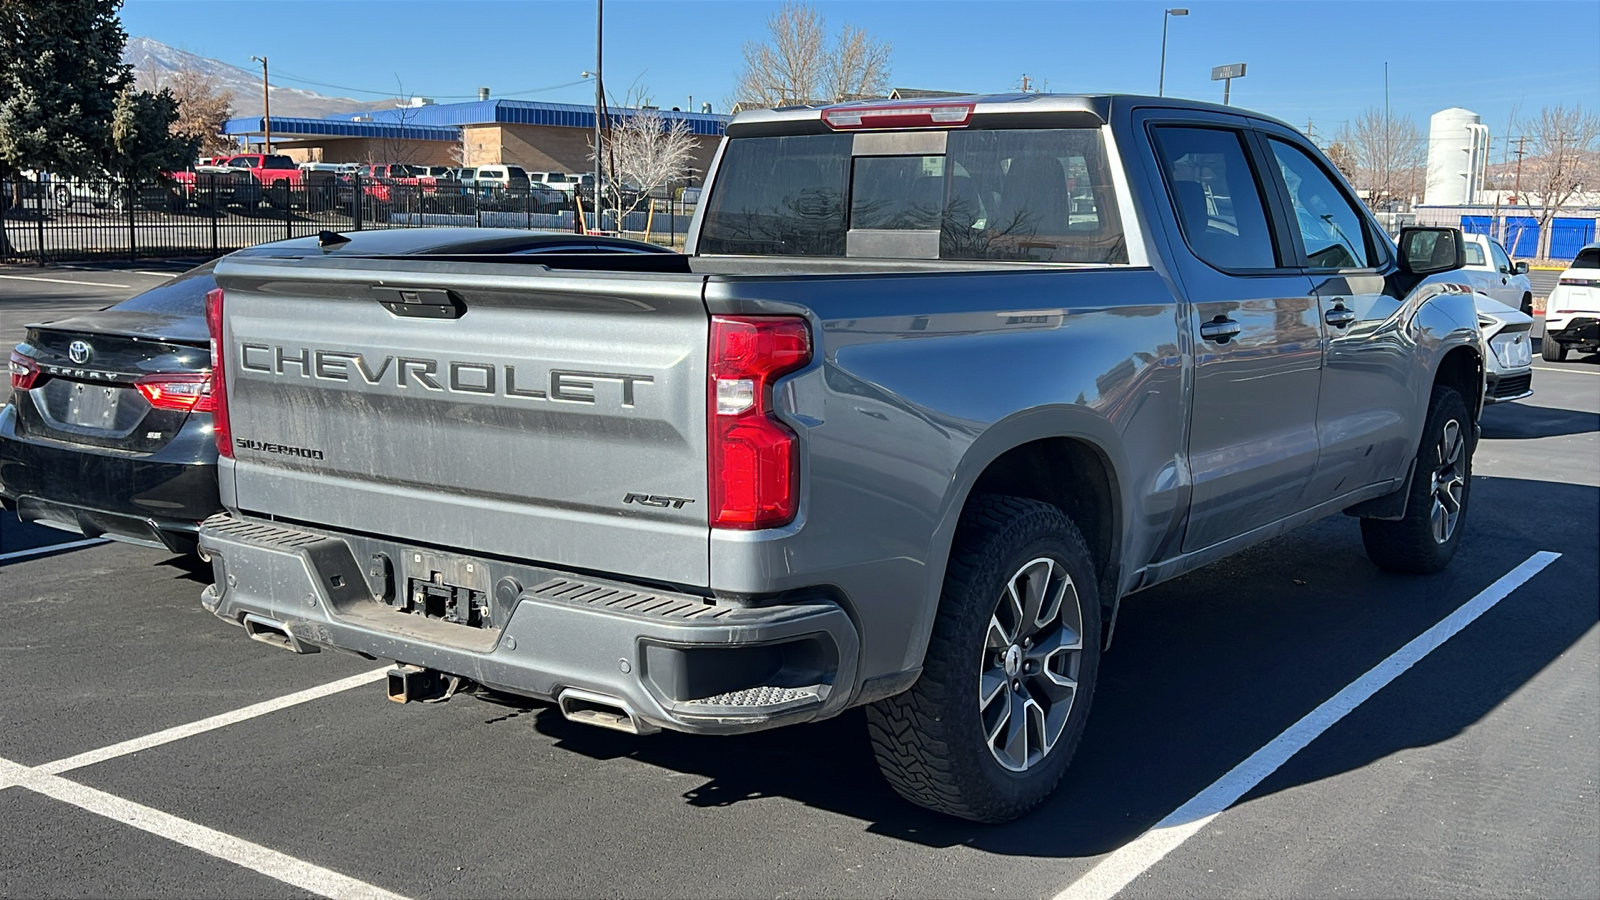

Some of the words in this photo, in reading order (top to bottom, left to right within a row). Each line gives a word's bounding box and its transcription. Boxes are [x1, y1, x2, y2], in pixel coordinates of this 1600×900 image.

[50, 367, 117, 380] CAMRY
[240, 343, 655, 407] CHEVROLET
[236, 438, 324, 460] SILVERADO
[623, 493, 695, 509] RST
